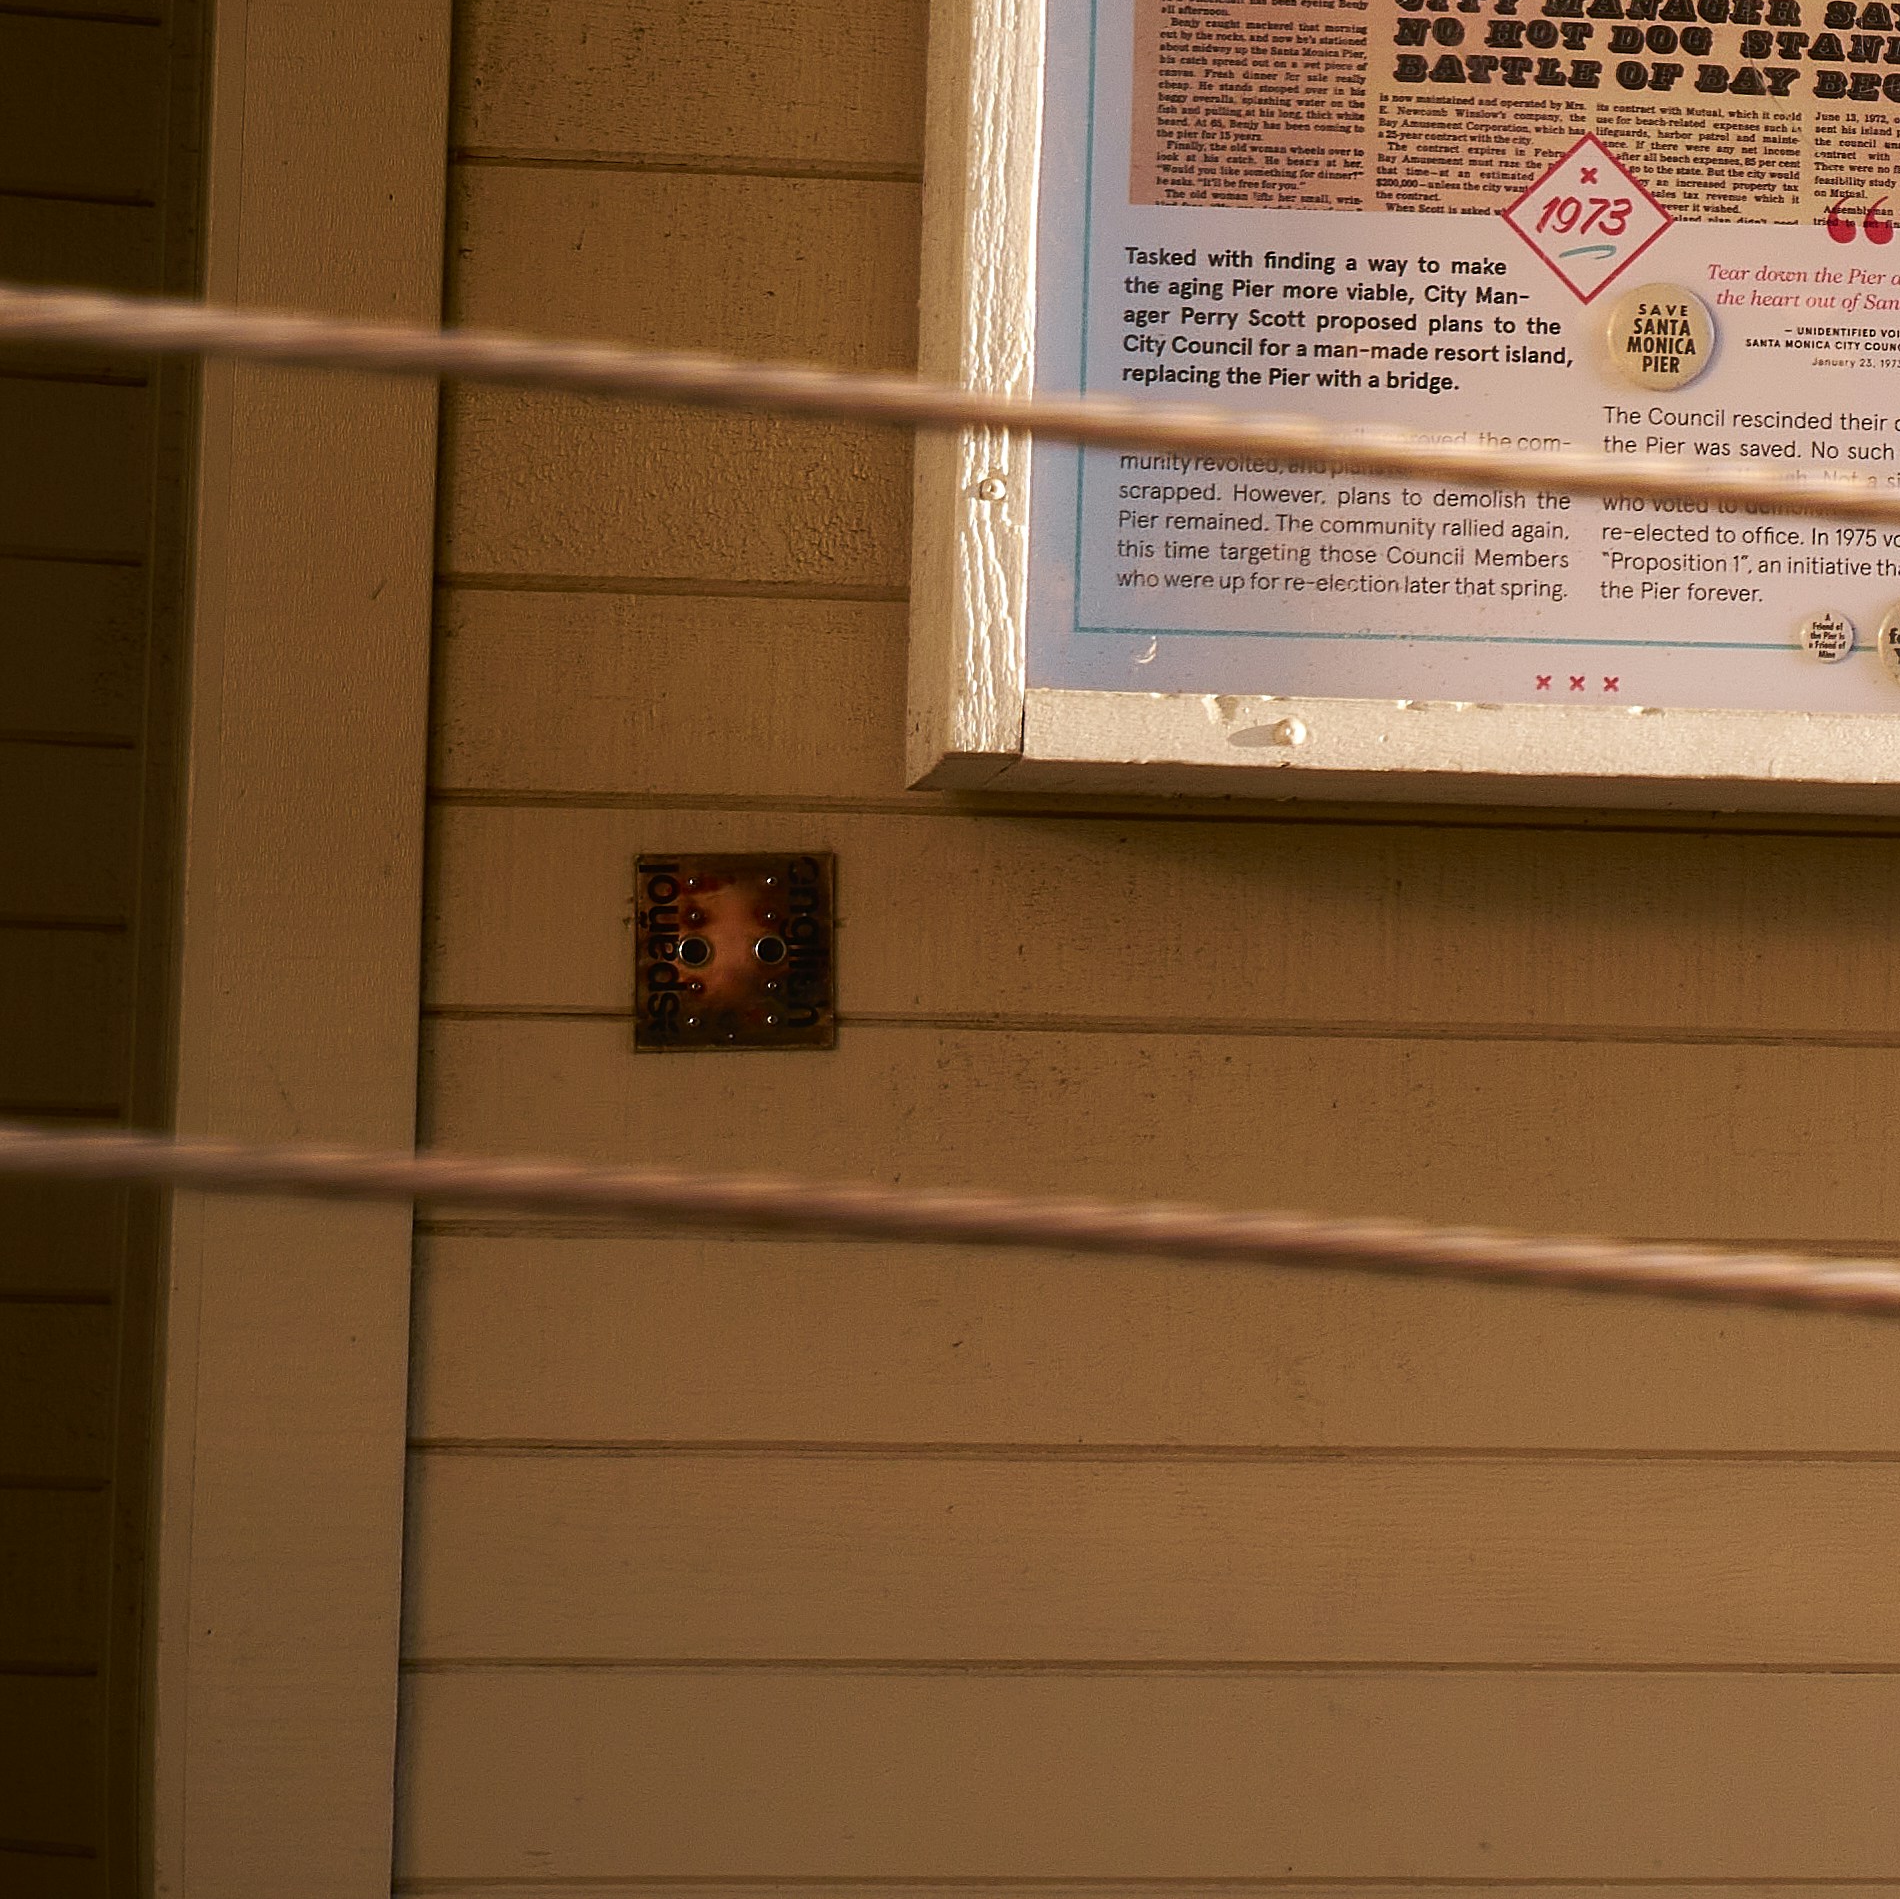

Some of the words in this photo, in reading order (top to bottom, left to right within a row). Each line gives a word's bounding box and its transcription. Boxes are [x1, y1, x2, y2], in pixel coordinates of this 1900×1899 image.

[1392, 16, 1466, 48] NO
[1483, 18, 1595, 52] HOT
[1606, 23, 1714, 57] DOG
[1392, 53, 1604, 90] BATTLE
[1614, 60, 1685, 92] OF
[1693, 62, 1802, 99] BAY
[1814, 111, 1841, 122] June
[1536, 196, 1633, 236] 1973
[1124, 246, 1197, 267] Tasked
[1207, 248, 1254, 269] with
[1262, 250, 1336, 276] finding
[1344, 257, 1358, 272] a
[1367, 258, 1409, 278] way
[1416, 255, 1441, 274] to
[1450, 256, 1508, 276] make
[1707, 263, 1751, 281] Tear
[1753, 264, 1808, 283] down
[1813, 266, 1844, 285] the
[1846, 267, 1887, 286] Pier
[1123, 275, 1160, 295] the
[1167, 276, 1225, 302] aging
[1231, 277, 1275, 299] Pier
[1282, 284, 1339, 301] more
[1345, 281, 1415, 307] viable,
[1423, 284, 1468, 309] City
[1475, 285, 1530, 306] Man-
[1715, 288, 1746, 306] the
[1749, 288, 1801, 308] heart
[1805, 295, 1837, 309] out
[1840, 291, 1863, 314] of
[1123, 309, 1172, 329] ager
[1180, 306, 1239, 331] Perry
[1247, 308, 1307, 329] Scott
[1315, 312, 1418, 335] proposed
[1427, 313, 1484, 337] plans
[1492, 316, 1517, 335] to
[1525, 316, 1562, 336] the
[1637, 302, 1688, 318] SAVE
[1632, 317, 1691, 337] SANTA
[1796, 326, 1878, 339] UNIDENTIFIED
[1122, 333, 1167, 358] City
[1170, 335, 1253, 356] Council
[1258, 337, 1292, 358] for
[1295, 343, 1308, 358] a
[1313, 341, 1429, 361] man-made
[1434, 344, 1501, 363] resort
[1505, 344, 1574, 369] island,
[1626, 335, 1697, 356] MONICA
[1745, 338, 1782, 349] SANTA
[1784, 339, 1831, 350] MONICA
[1833, 340, 1862, 351] CITY
[1641, 354, 1681, 374] PIER
[1811, 357, 1857, 369] January
[1858, 357, 1877, 369] 23,
[1599, 580, 1635, 600] the
[1640, 580, 1682, 601] Pier
[1686, 582, 1764, 603] forever.
